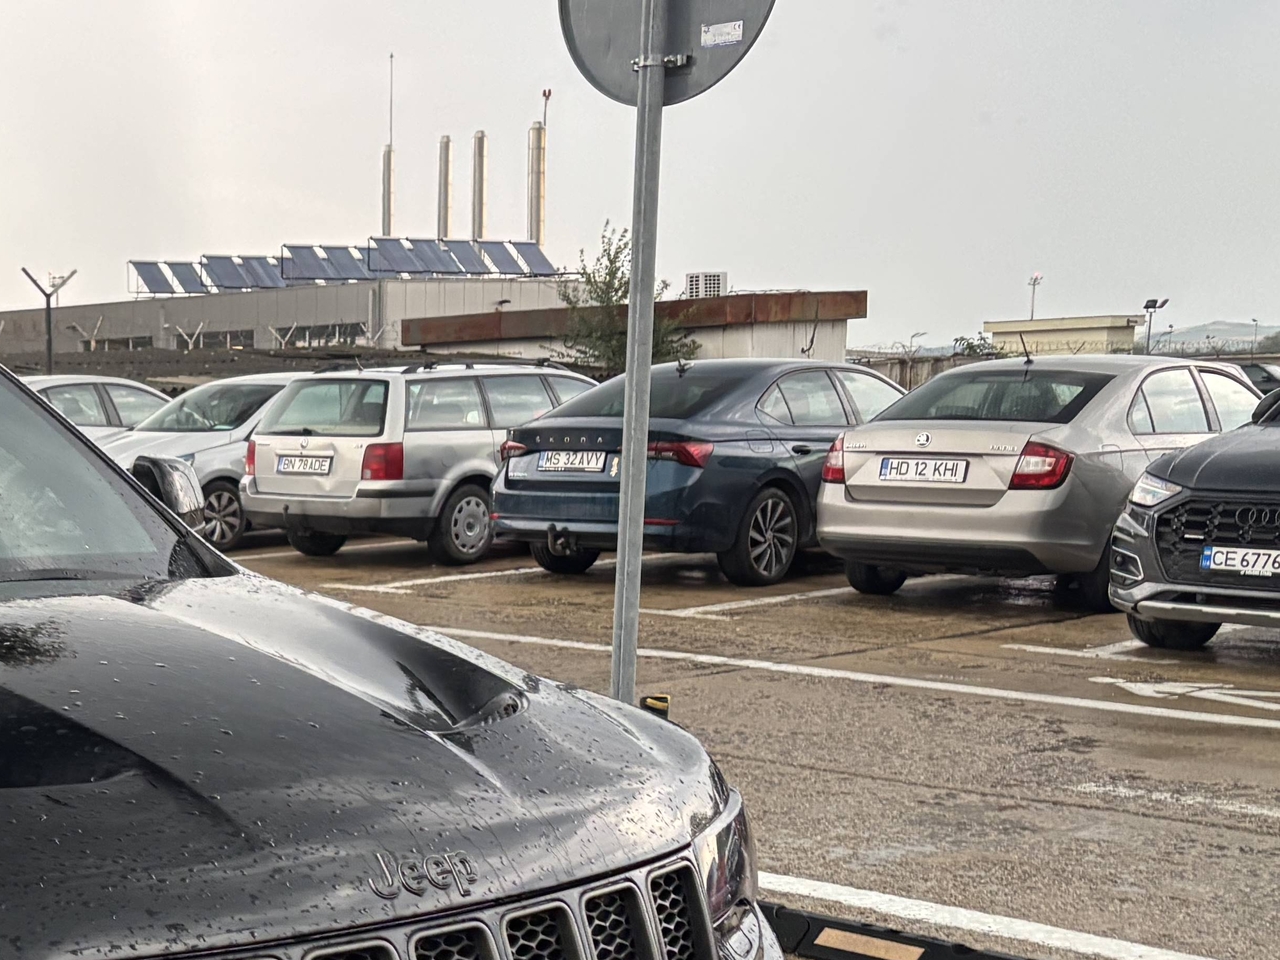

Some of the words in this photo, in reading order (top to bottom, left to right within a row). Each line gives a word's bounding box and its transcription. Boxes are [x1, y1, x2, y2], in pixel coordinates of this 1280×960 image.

[282, 458, 295, 470] BN
[297, 458, 308, 471] 78
[308, 459, 328, 472] ADE
[545, 452, 561, 466] MS
[563, 452, 577, 466] 32
[578, 452, 603, 466] AVY
[888, 460, 909, 476] HD
[914, 461, 927, 477] 12
[932, 462, 959, 477] KHI
[1213, 551, 1237, 567] CE
[1241, 552, 1280, 570] 6776
[367, 849, 478, 900] Jeep
